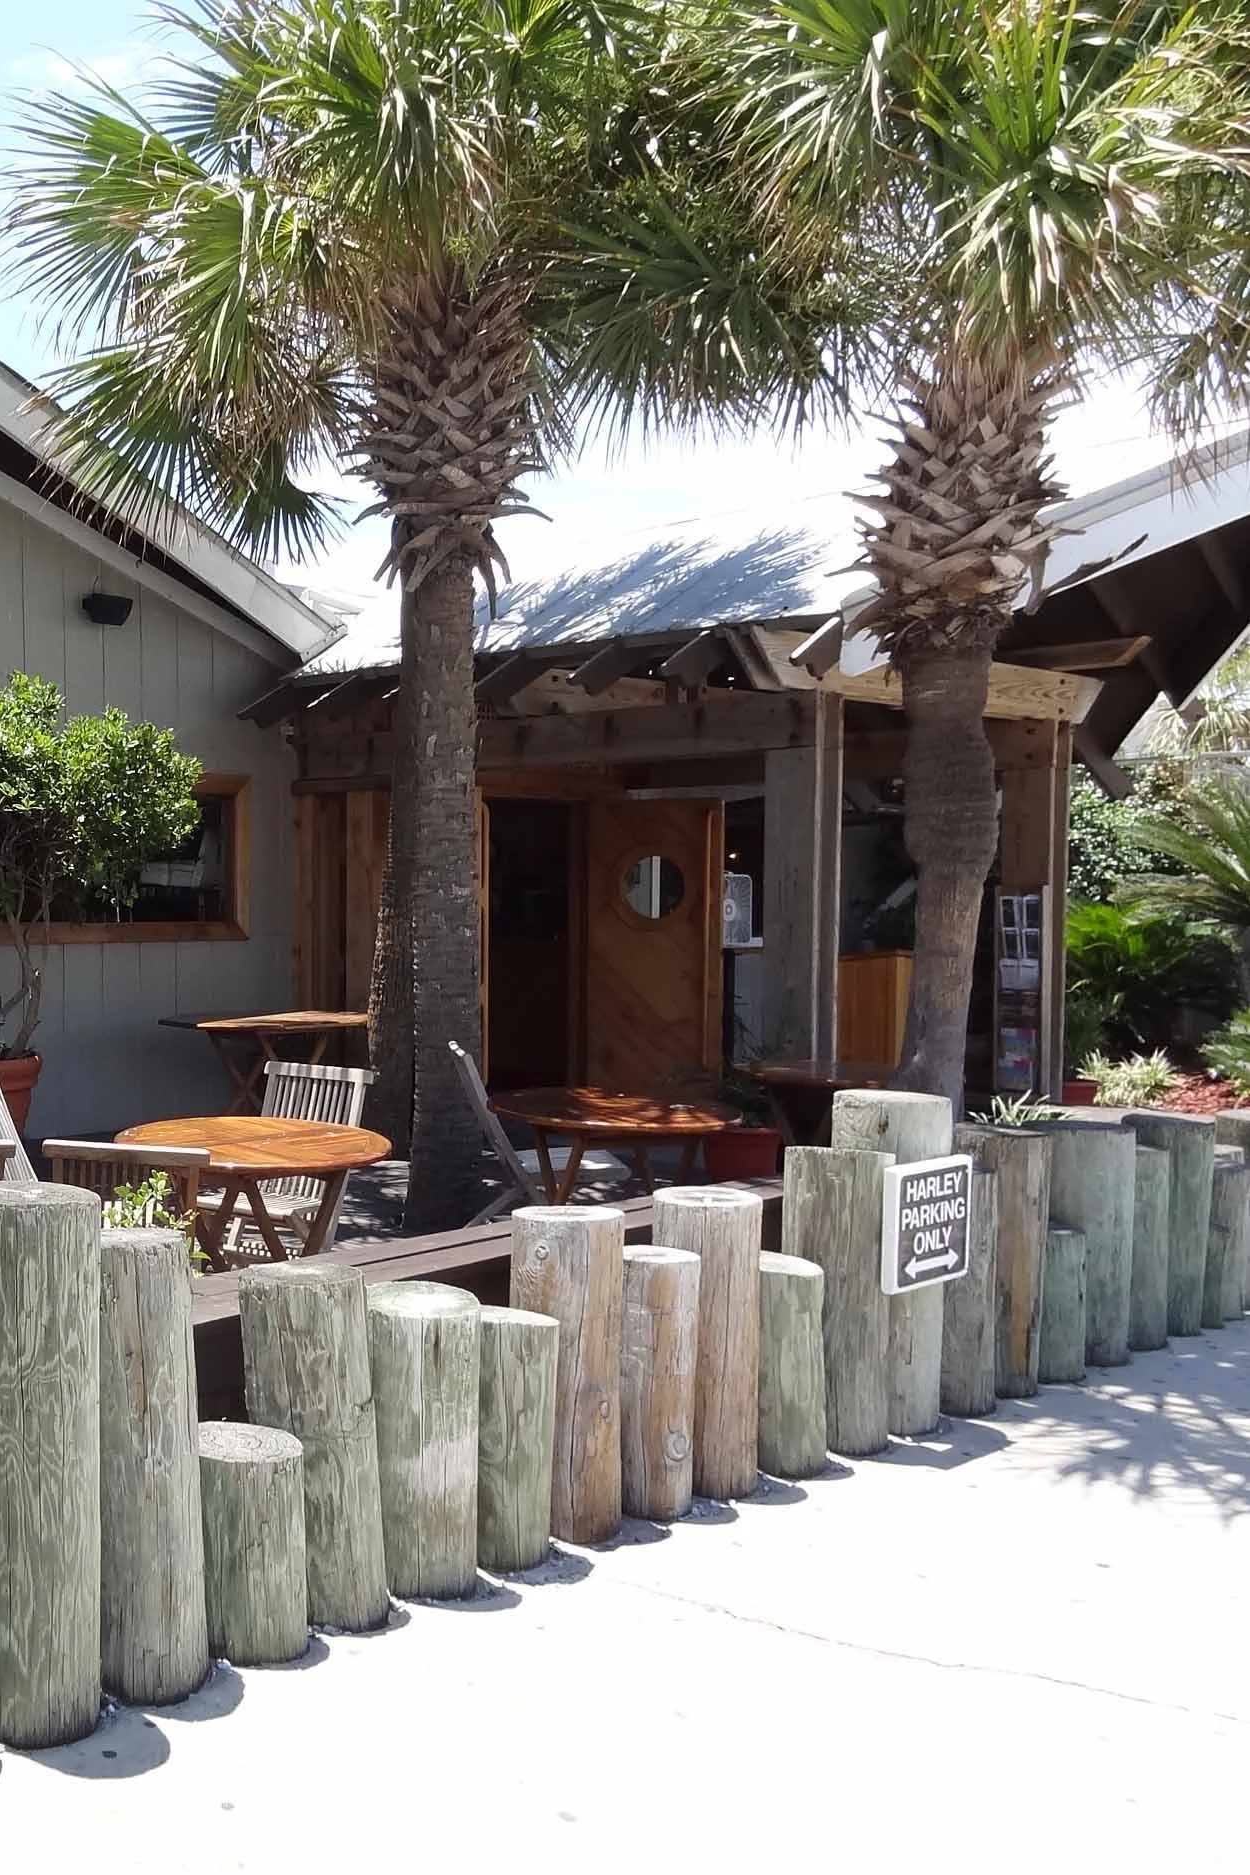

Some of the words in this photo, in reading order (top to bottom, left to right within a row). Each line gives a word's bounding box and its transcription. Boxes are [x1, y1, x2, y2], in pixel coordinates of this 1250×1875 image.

[906, 1171, 963, 1203] HARLEY
[901, 1196, 966, 1231] PARKING
[913, 1225, 952, 1255] ONLY
